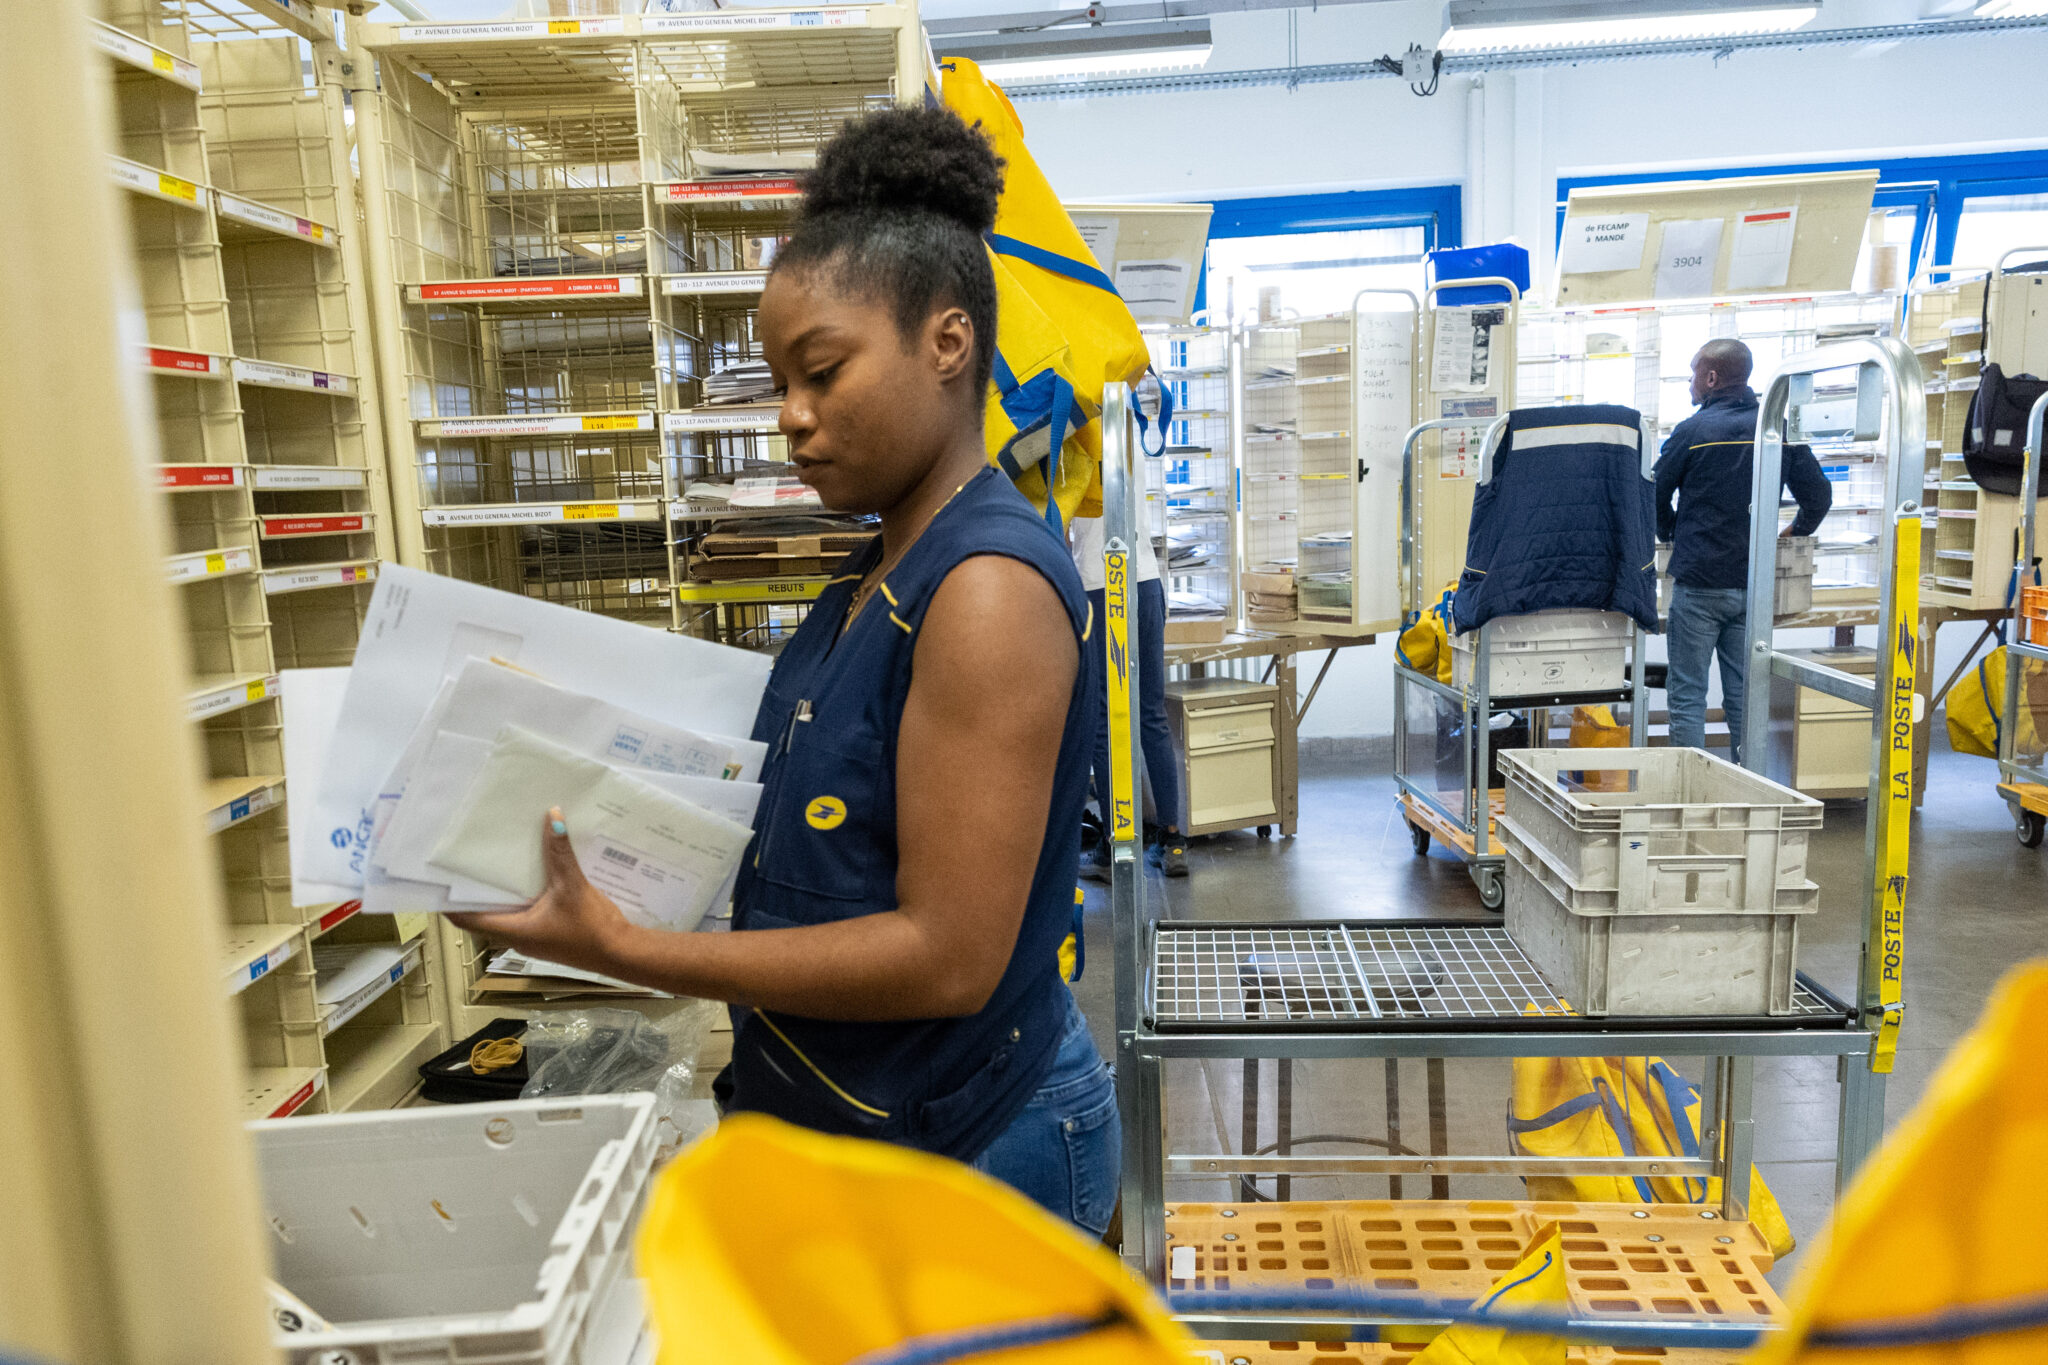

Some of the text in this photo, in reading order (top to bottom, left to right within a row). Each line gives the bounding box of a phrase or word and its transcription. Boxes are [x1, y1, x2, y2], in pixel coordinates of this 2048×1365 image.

[1598, 222, 1630, 231] FECAMP
[1595, 234, 1624, 242] MANDE
[1672, 256, 1702, 268] 3904
[768, 583, 804, 592] REBUTS
[1108, 554, 1124, 618] OSTE
[1893, 676, 1912, 801] LA POSTE
[1116, 798, 1131, 829] LA
[1883, 910, 1901, 982] POSTE
